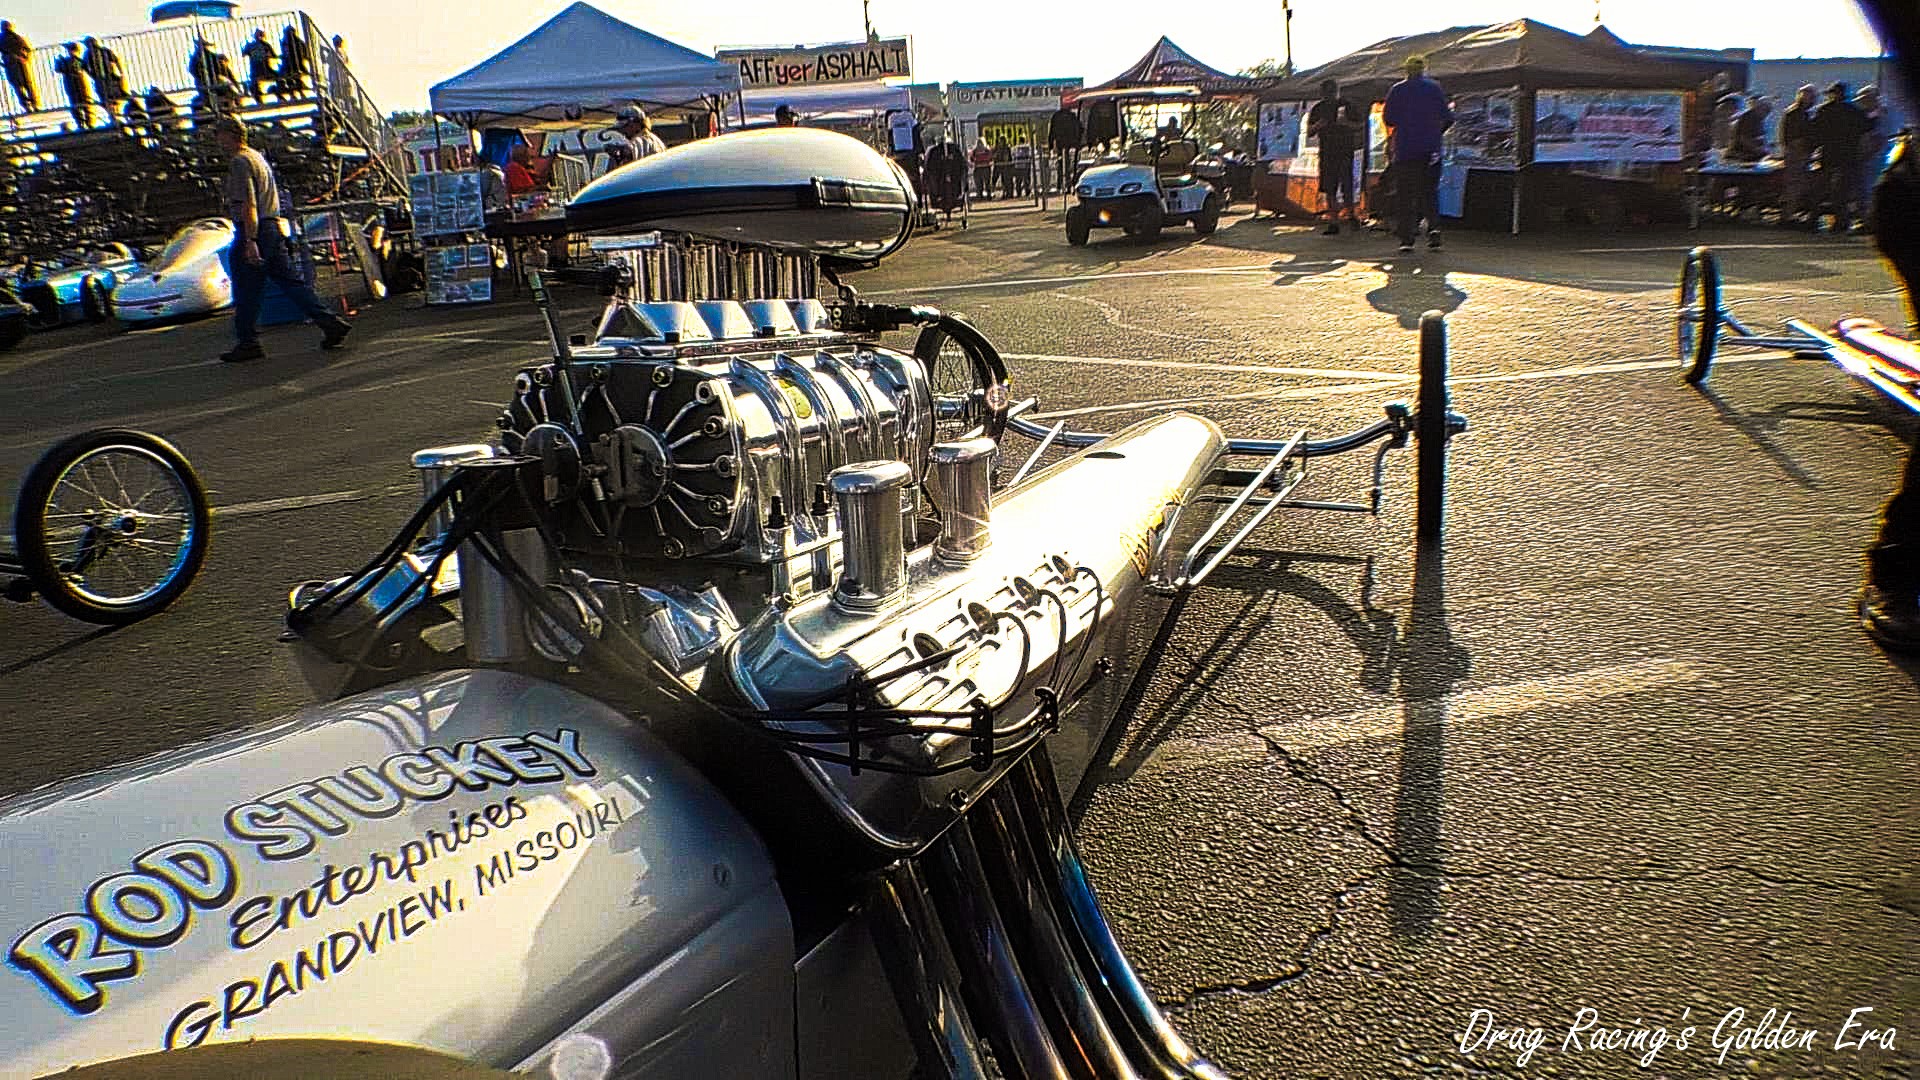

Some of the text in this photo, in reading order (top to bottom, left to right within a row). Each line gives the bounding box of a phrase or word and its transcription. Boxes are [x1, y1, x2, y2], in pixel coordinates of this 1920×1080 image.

[816, 48, 905, 81] ASPHALT
[5, 728, 598, 1016] ROD STUCKEY
[164, 797, 625, 1049] GRANDVIEW, MISSOURI
[230, 796, 527, 950] Enterprises
